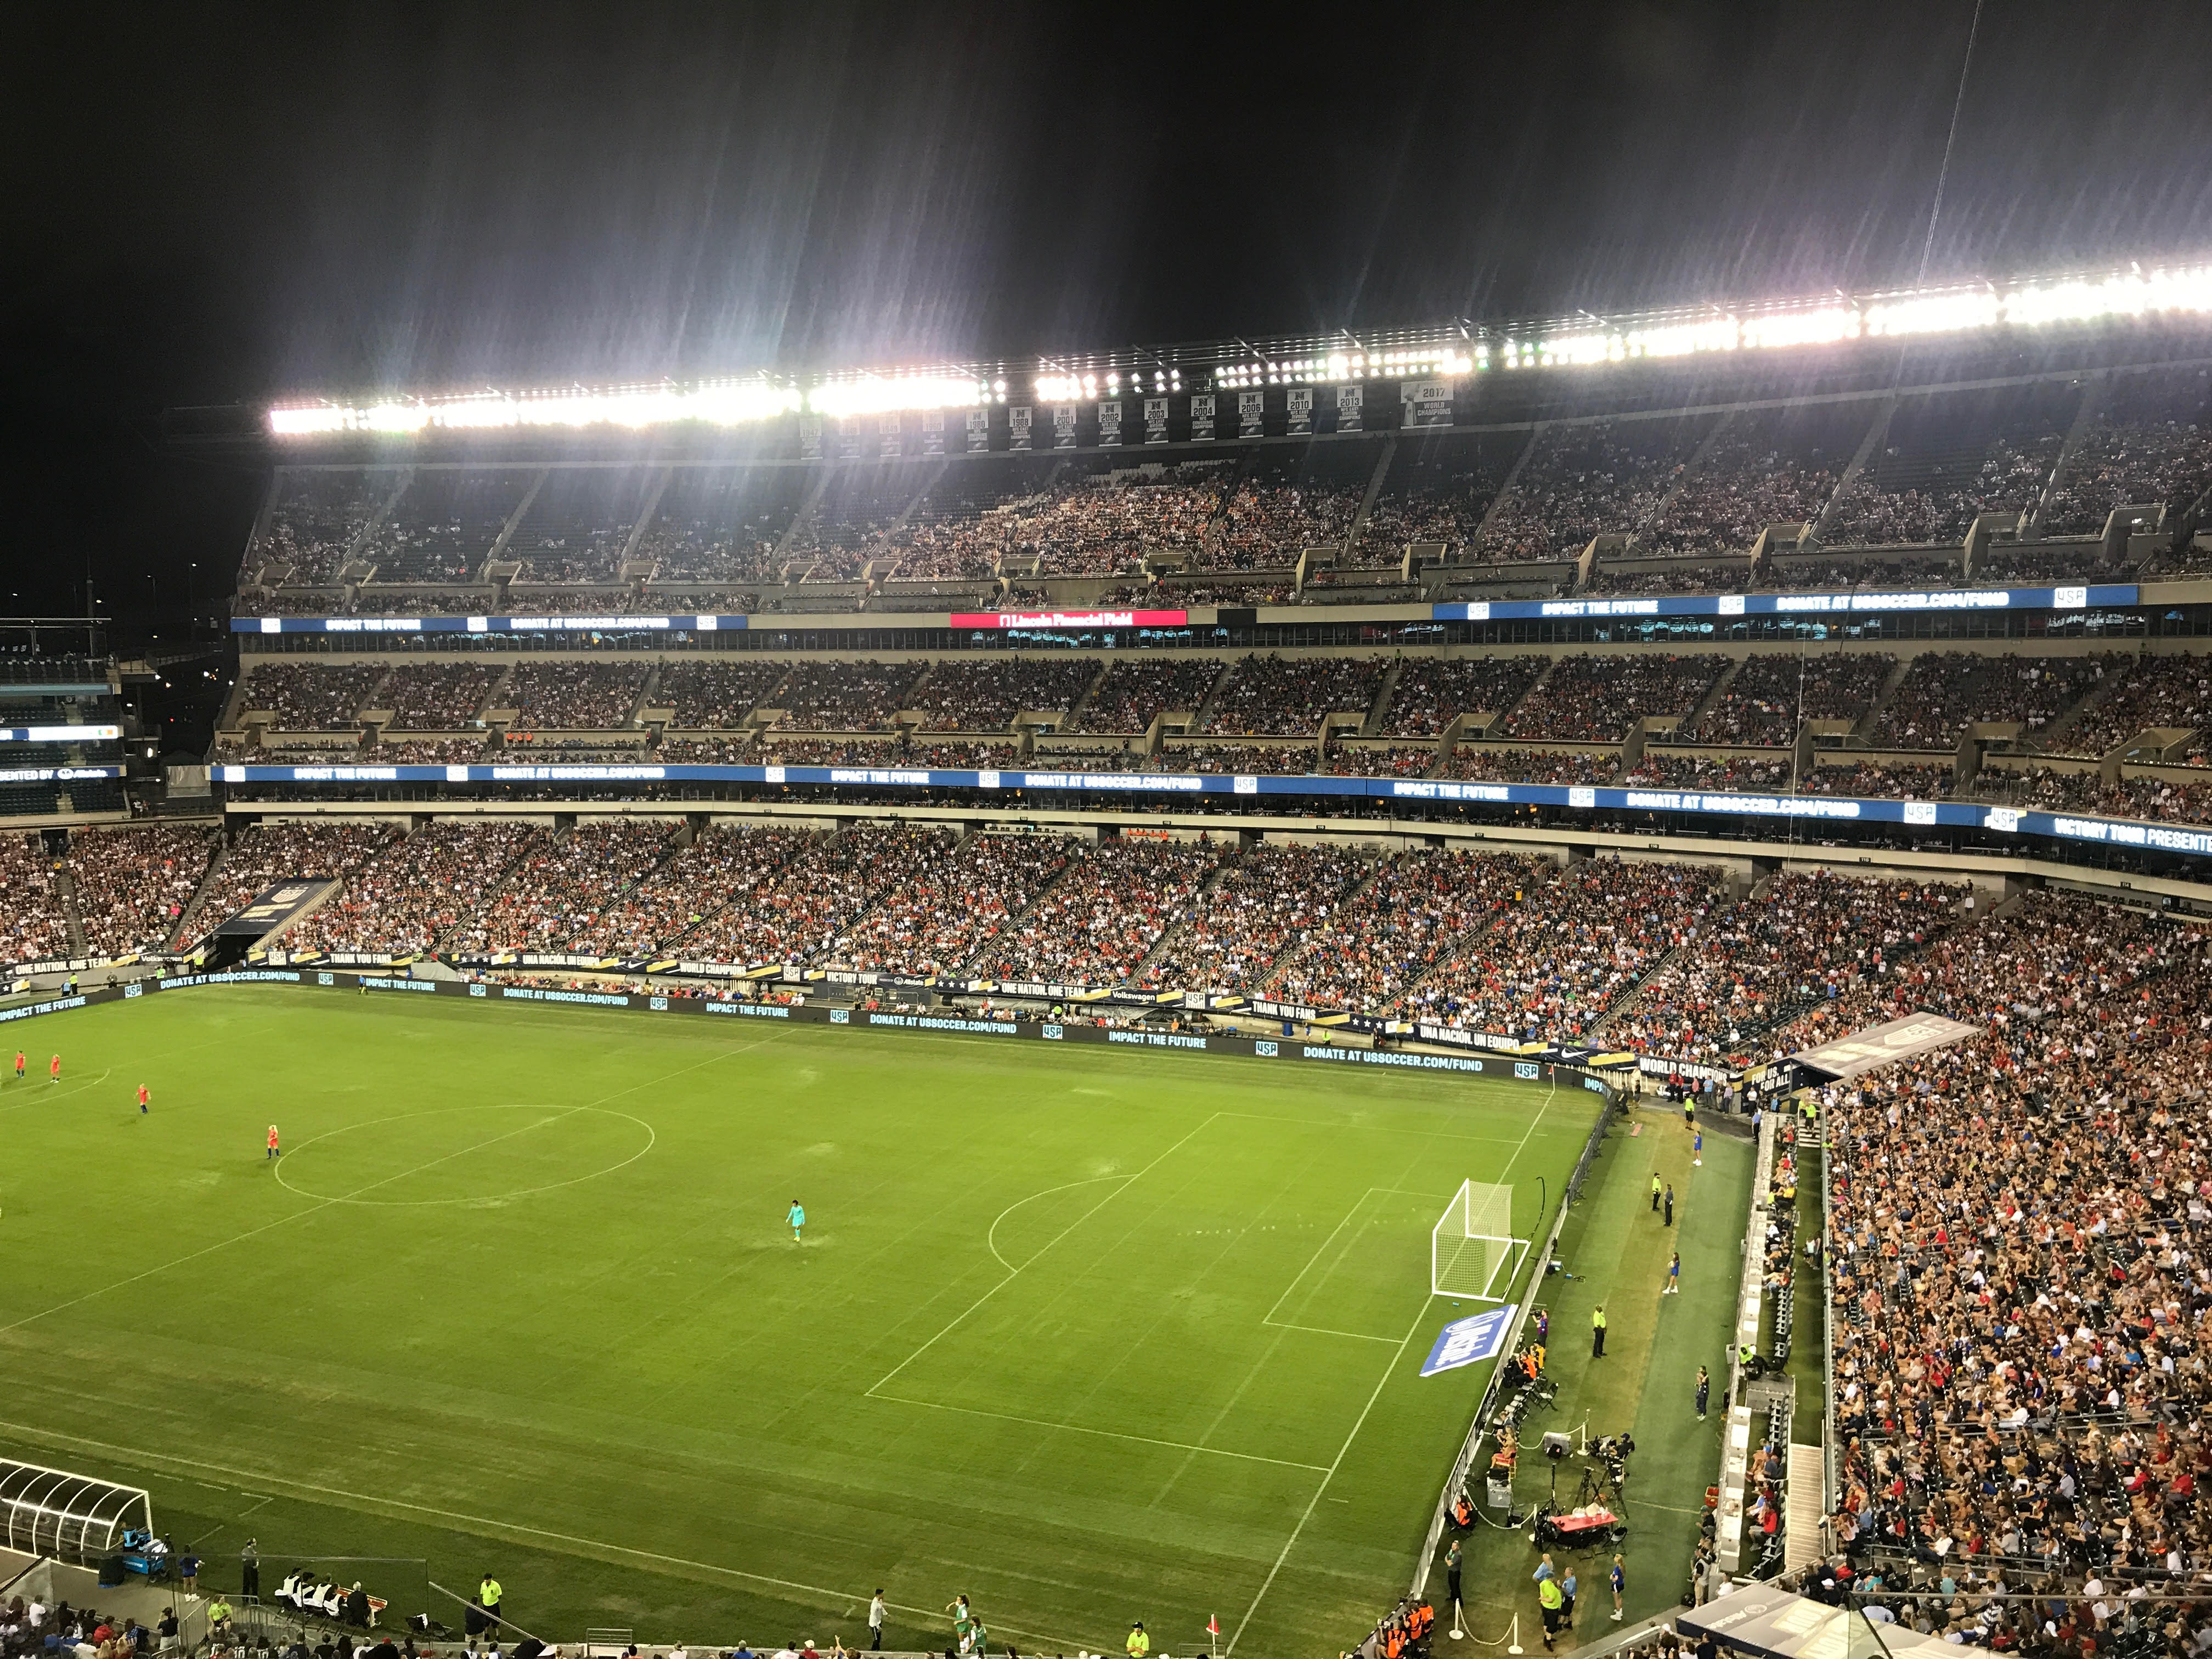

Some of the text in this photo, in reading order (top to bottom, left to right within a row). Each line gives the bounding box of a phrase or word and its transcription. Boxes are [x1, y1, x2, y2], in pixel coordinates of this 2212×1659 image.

[1423, 388, 1445, 397] 2017
[1242, 404, 1261, 413] 2006
[1290, 400, 1309, 410] 2010
[1340, 397, 1359, 406] 2013
[1101, 413, 1119, 422] 2002
[1148, 410, 1165, 419] 2003
[1194, 407, 1212, 416] 2004
[1418, 408, 1451, 416] CHAMPIONS
[969, 420, 985, 428] 1980
[1012, 418, 1029, 426] 1988
[1057, 416, 1073, 425] 2001
[2058, 589, 2084, 603] USA
[1012, 613, 1132, 627] Lincoln Financial Field
[0, 771, 38, 780] SENTED
[40, 770, 53, 779] BY
[1907, 805, 1933, 819] USA
[2055, 818, 2212, 852] VICTORY TOUR PRESENTE
[330, 953, 392, 964] THANK YOU FANS
[523, 955, 538, 964] UNA
[567, 956, 576, 965] UN
[15, 957, 114, 975] ONE NATION. ONE TEAM.
[680, 962, 746, 977] WORLD CHAMPIONS
[160, 971, 300, 989] DONATE AT USSOCCER.COM/FUND
[367, 978, 435, 991] IMPACT THE FUTURE
[826, 970, 857, 983] VICTORY
[858, 972, 877, 985] TOUR
[504, 988, 628, 1005] DONATE AT USSOCCER.COM/FUND
[1002, 982, 1017, 994] ONE
[1018, 983, 1048, 996] NATION.
[1048, 985, 1064, 997] ONE
[1113, 991, 1155, 1002] Volkswagen
[0, 996, 86, 1020] IMPACT THE FUTURE
[707, 1002, 788, 1017] IMPACT THE FUTURE
[1252, 1000, 1316, 1020] THANK YOU FANS
[870, 1014, 1017, 1034] DONATE AT USSOCCER.COM/FUND
[1109, 1031, 1206, 1048] IMPACT THE FUTURE
[1420, 1025, 1437, 1039] UNA
[1474, 1034, 1486, 1046] UN
[1304, 1047, 1482, 1071] DONATE AT USSOCCER.COM/FUND
[1516, 1064, 1537, 1077] USA
[1640, 1058, 1727, 1084] WORLD CHAMPIONS
[1752, 1066, 1779, 1085] FOR US.
[1760, 1073, 1790, 1091] FOR ALL.
